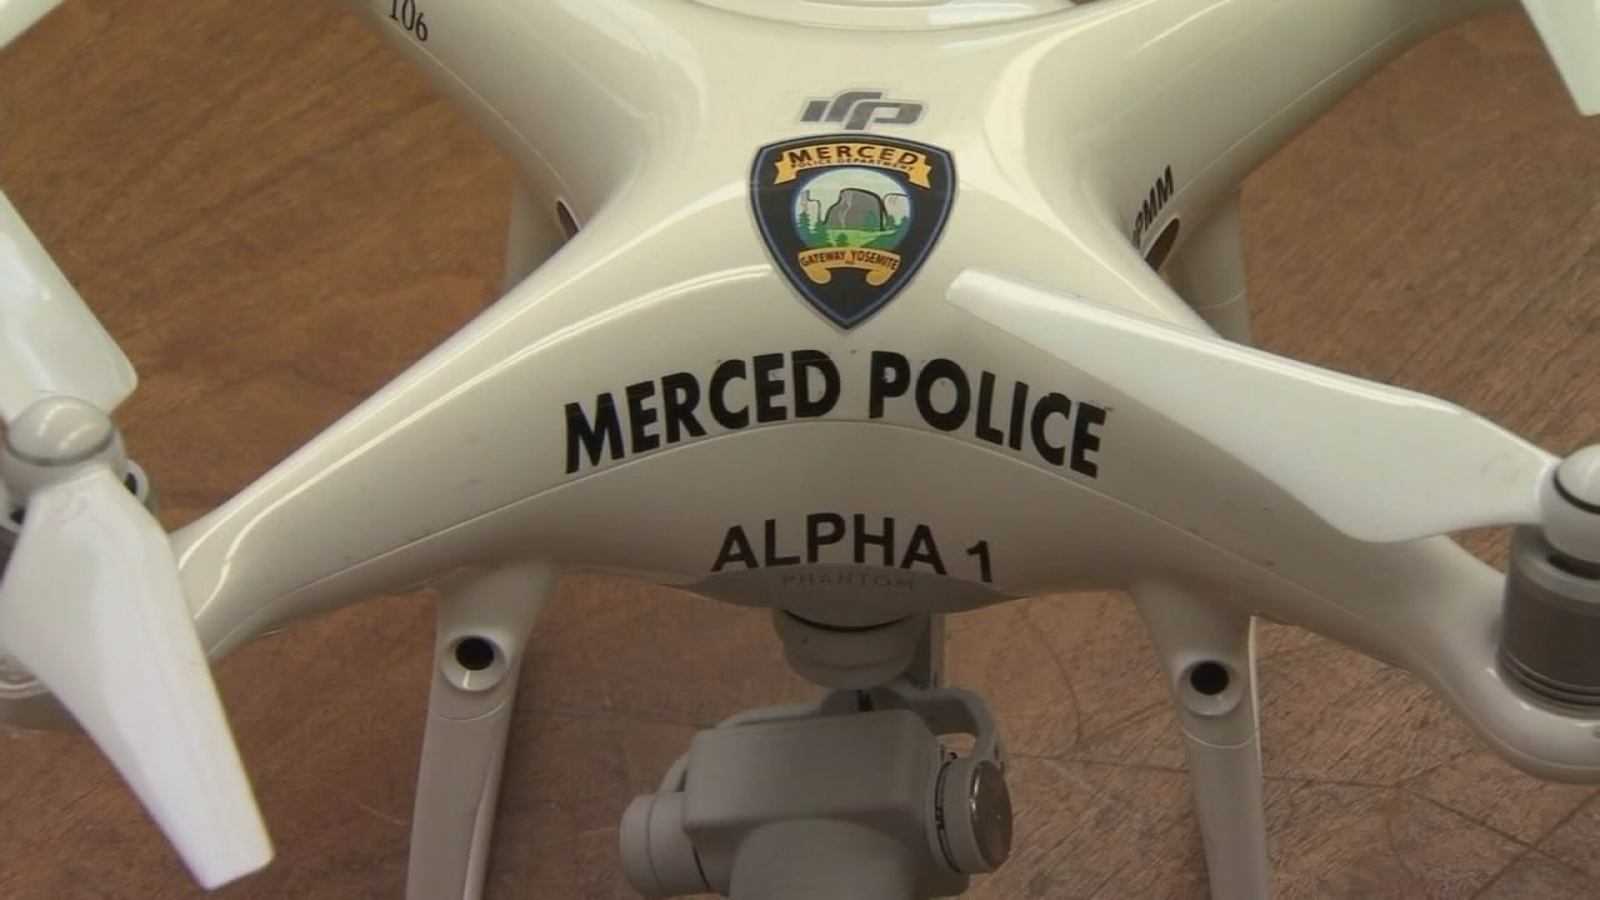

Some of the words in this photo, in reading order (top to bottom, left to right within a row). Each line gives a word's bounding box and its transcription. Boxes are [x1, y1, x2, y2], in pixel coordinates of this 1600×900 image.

[788, 145, 920, 166] MERCED
[790, 159, 832, 169] POLICE
[837, 157, 916, 172] DEPARTMENT
[800, 250, 846, 267] GATEWAY
[849, 250, 900, 271] YOSEMITE
[564, 349, 842, 475] MERCED
[868, 350, 1107, 479] POLICE
[709, 512, 948, 576] ALPHA
[966, 540, 994, 583] 1
[781, 573, 915, 591] PHANTOM
